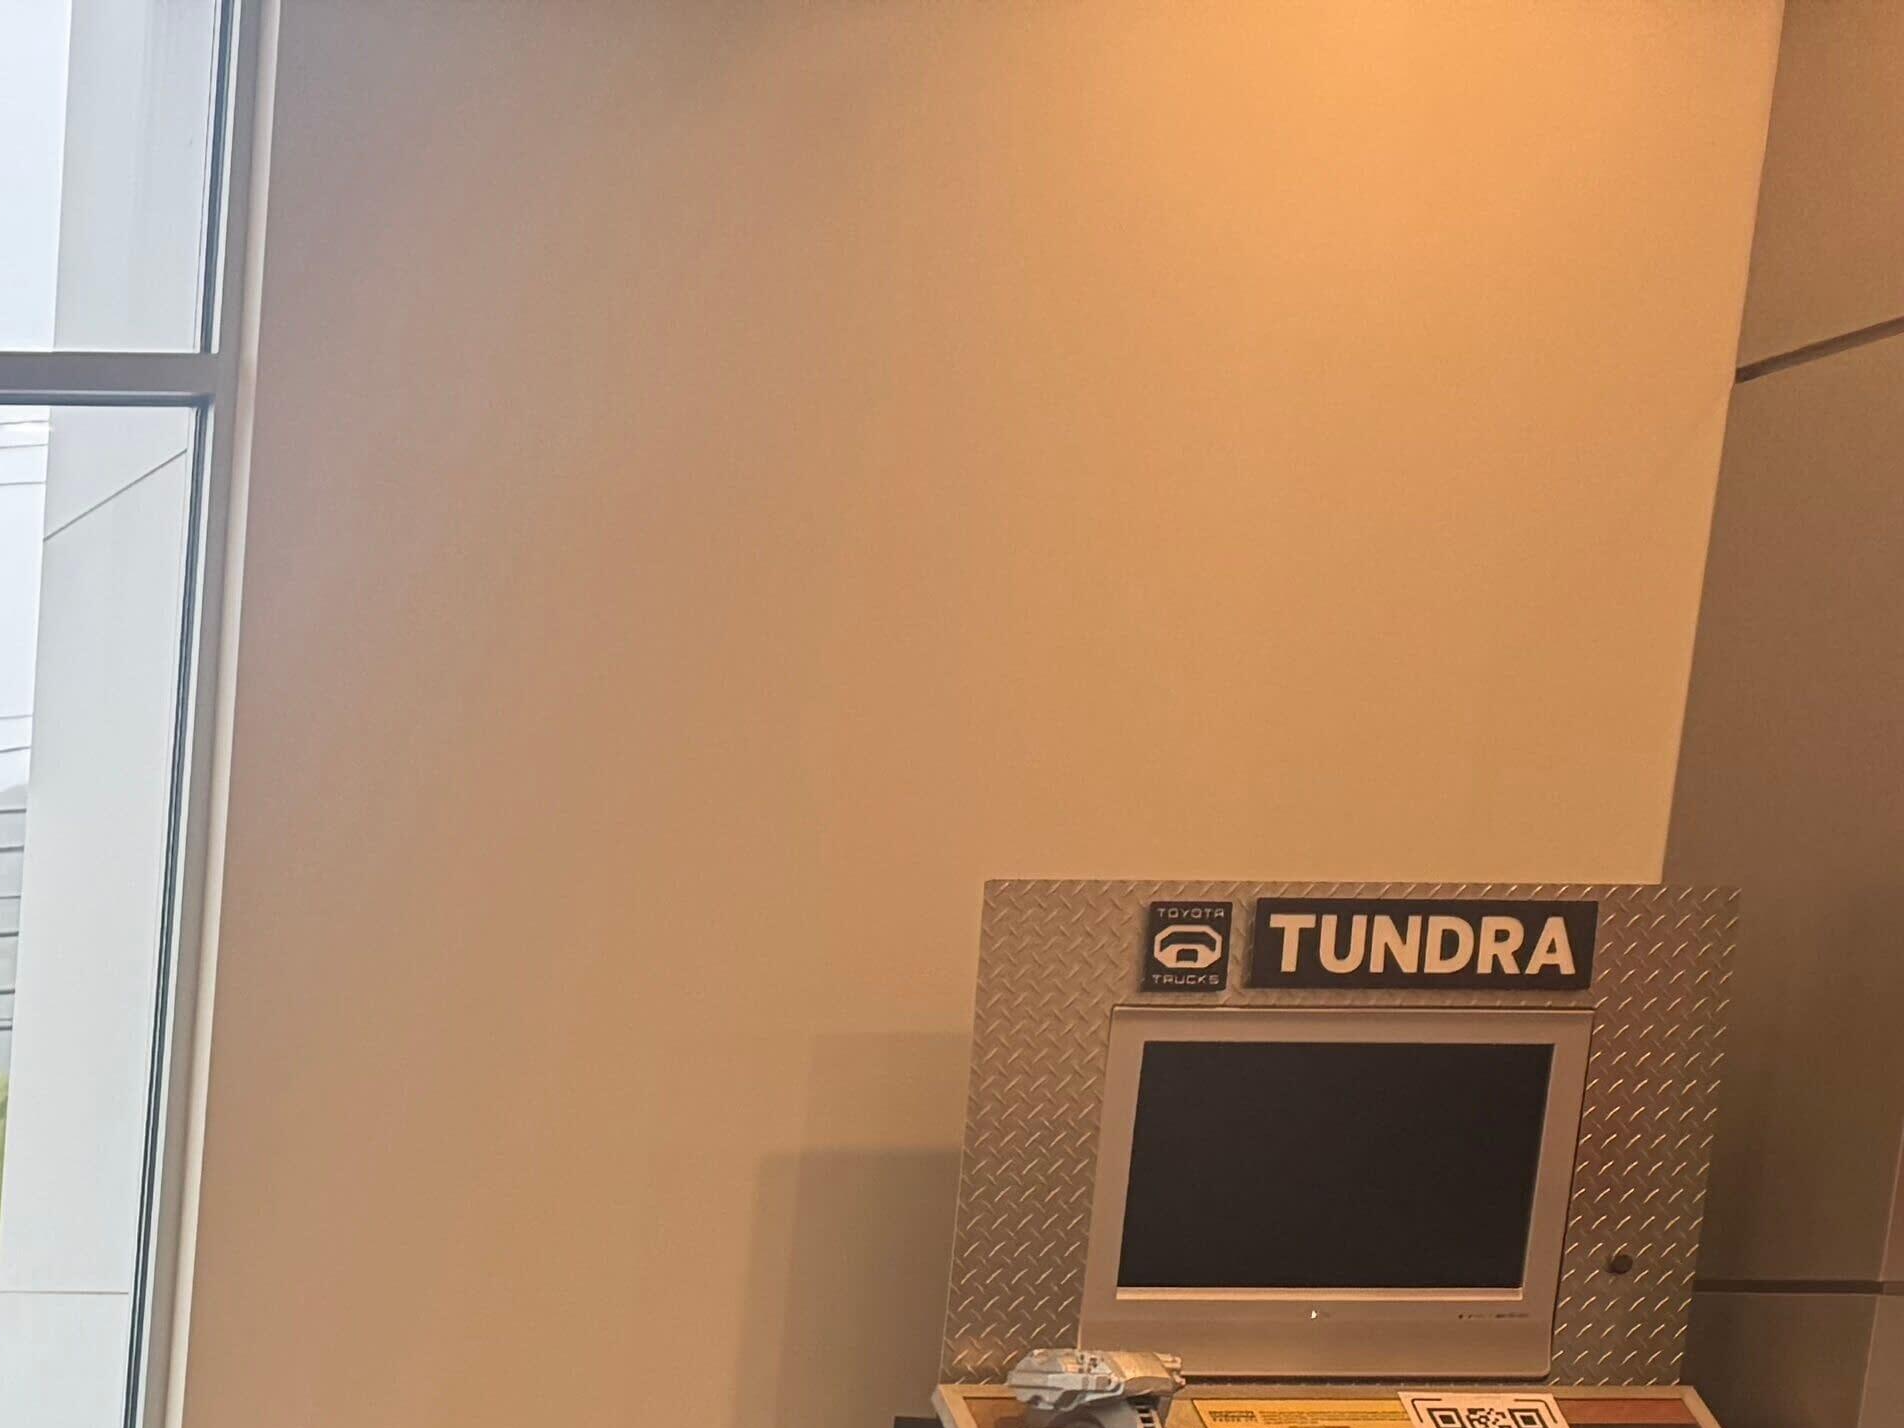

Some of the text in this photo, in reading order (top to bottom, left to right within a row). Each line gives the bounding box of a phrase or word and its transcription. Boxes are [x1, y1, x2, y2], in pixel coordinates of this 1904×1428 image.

[1157, 907, 1225, 919] TOYOTA
[1268, 914, 1577, 975] TUNDRA
[1151, 973, 1220, 985] TRUCKS
